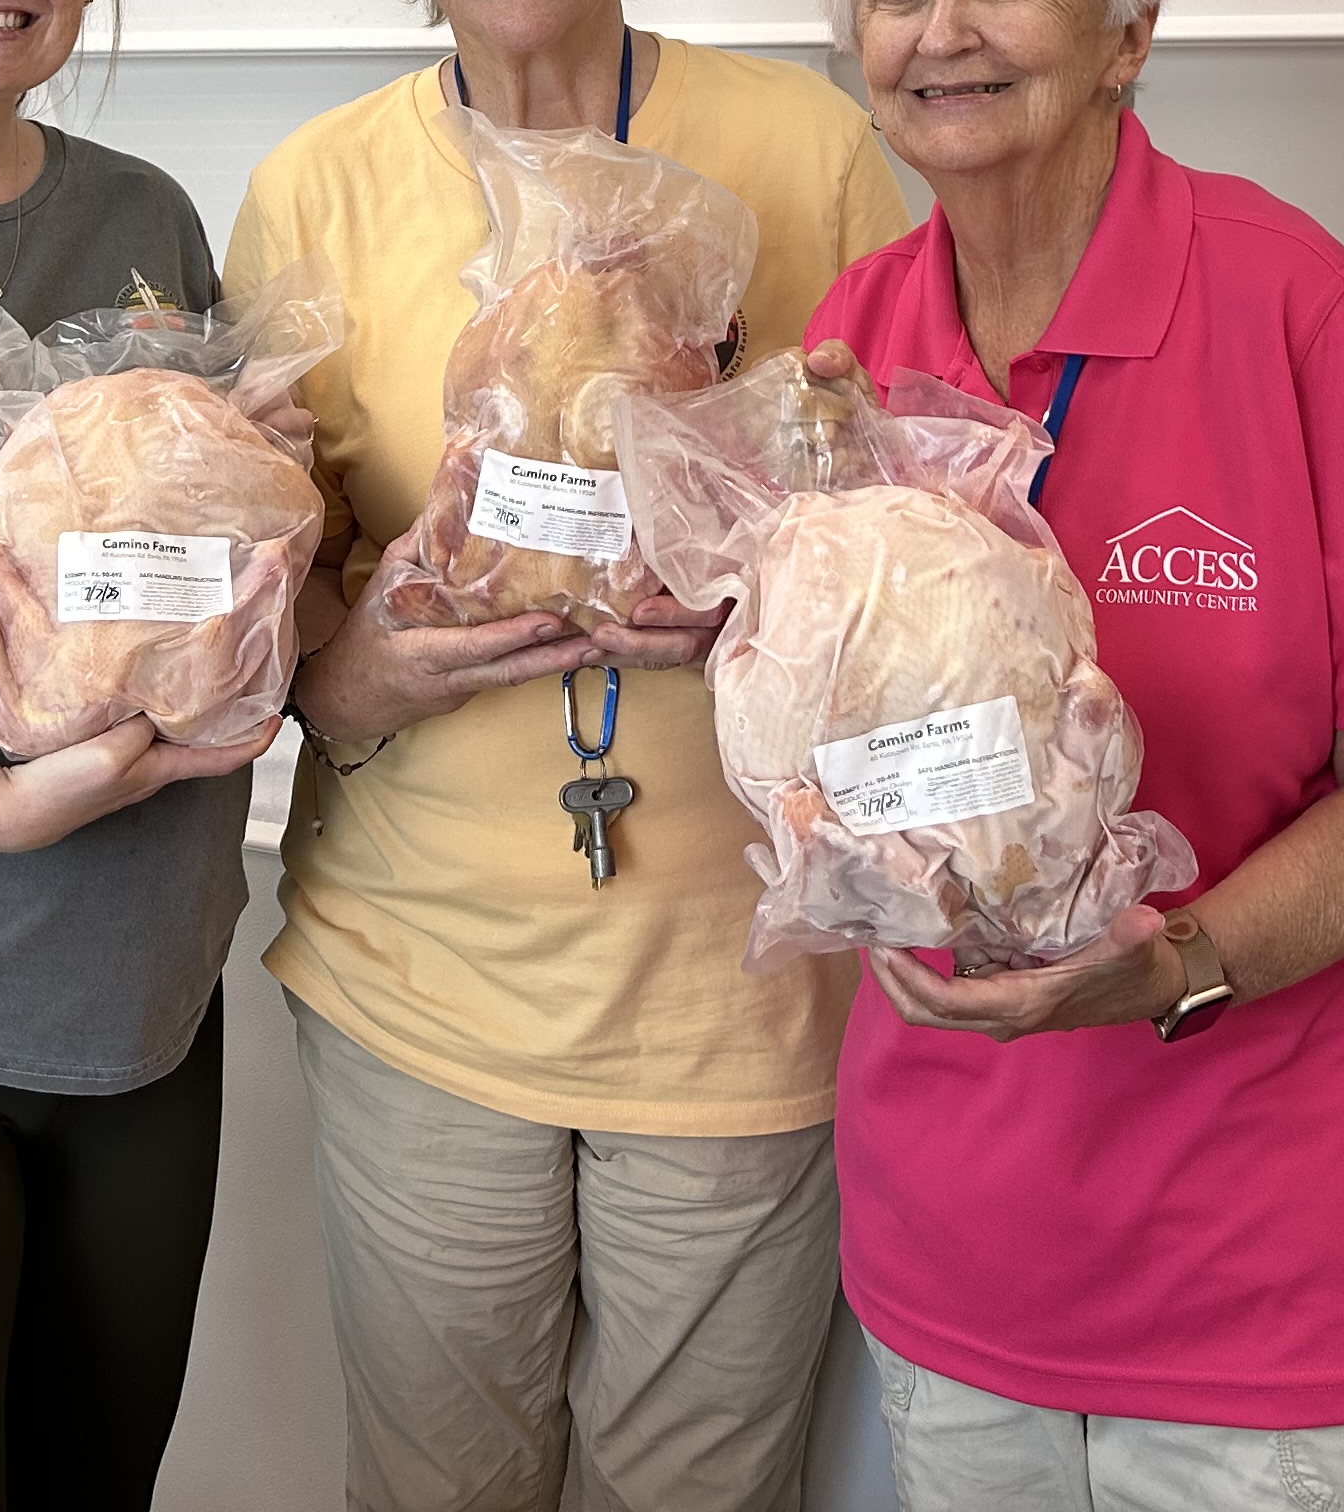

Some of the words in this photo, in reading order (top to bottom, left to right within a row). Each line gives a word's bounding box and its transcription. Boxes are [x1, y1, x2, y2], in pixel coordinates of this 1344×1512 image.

[560, 473, 597, 488] Farms
[102, 538, 150, 551] Camino
[153, 541, 188, 555] Farms
[1097, 541, 1259, 591] ACCESS
[1096, 588, 1193, 607] COMMUNITY
[1196, 592, 1258, 612] CENTER
[868, 730, 924, 751] Camino
[926, 718, 971, 737] Farms
